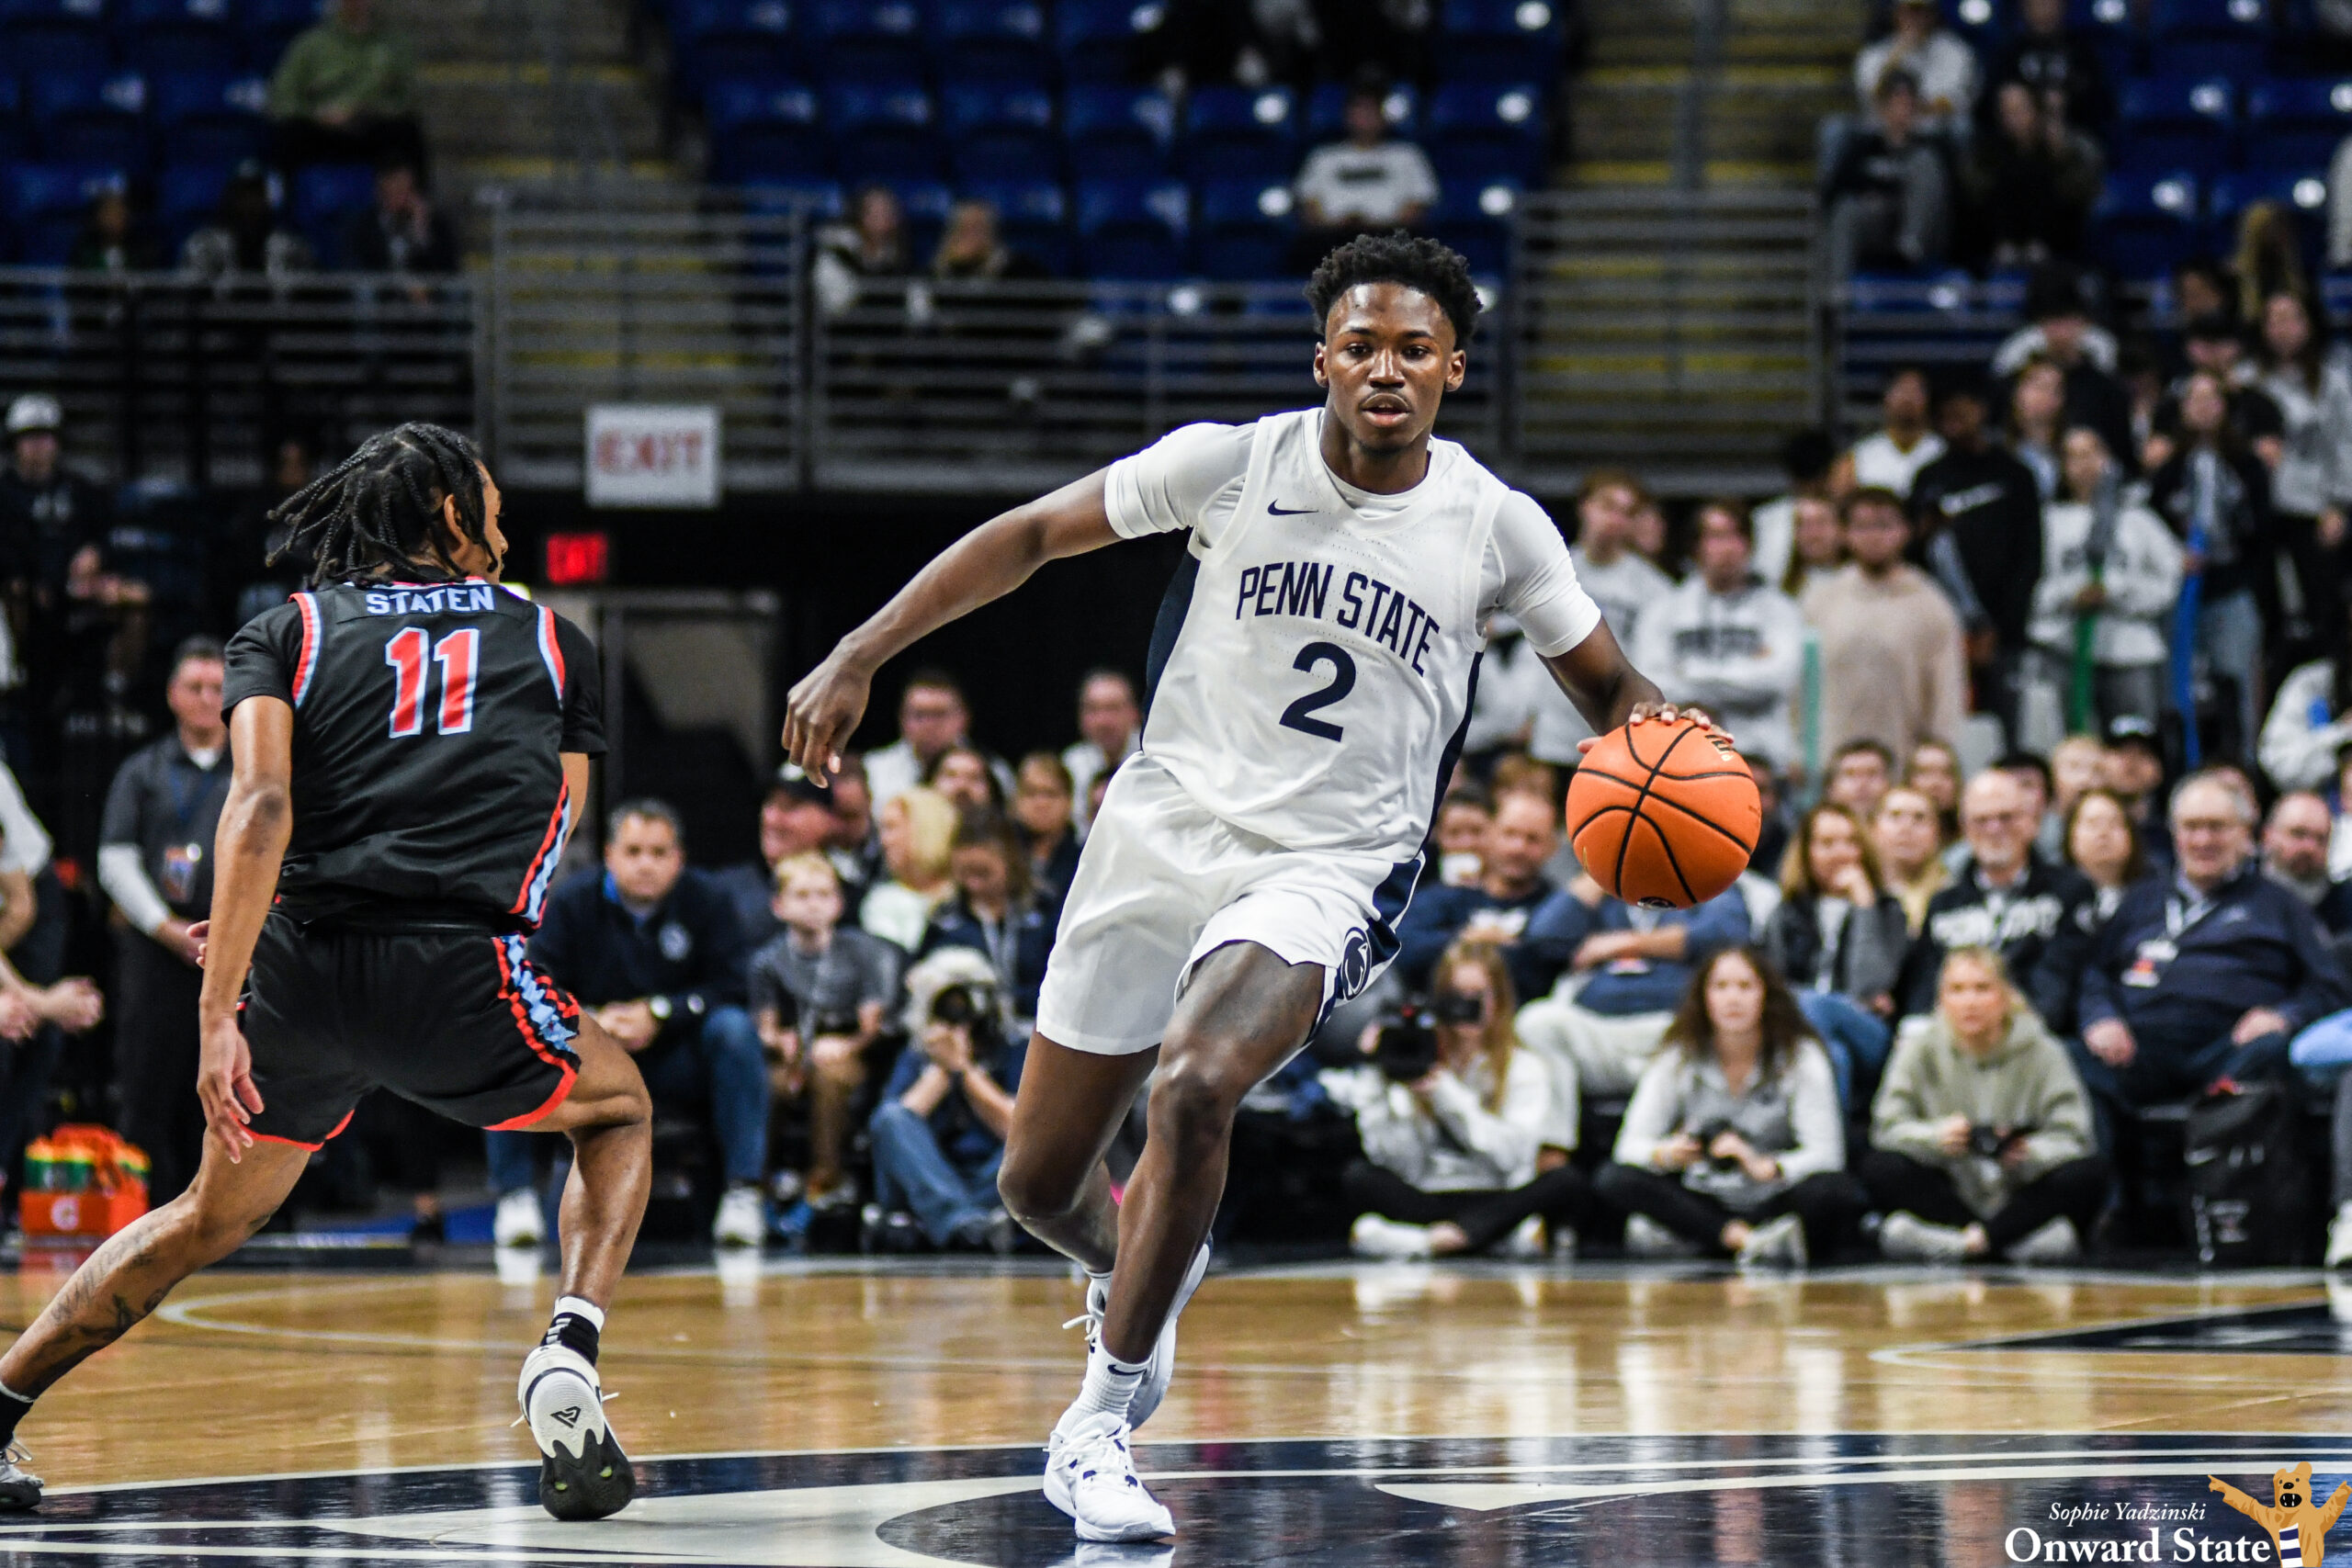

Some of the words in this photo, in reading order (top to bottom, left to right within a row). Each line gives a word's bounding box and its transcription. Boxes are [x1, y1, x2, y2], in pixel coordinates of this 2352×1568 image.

[366, 586, 495, 615] STATEN
[1236, 561, 1334, 620] PENN
[1337, 570, 1441, 678] STATE
[385, 626, 480, 739] 11
[1279, 641, 1356, 742] 2
